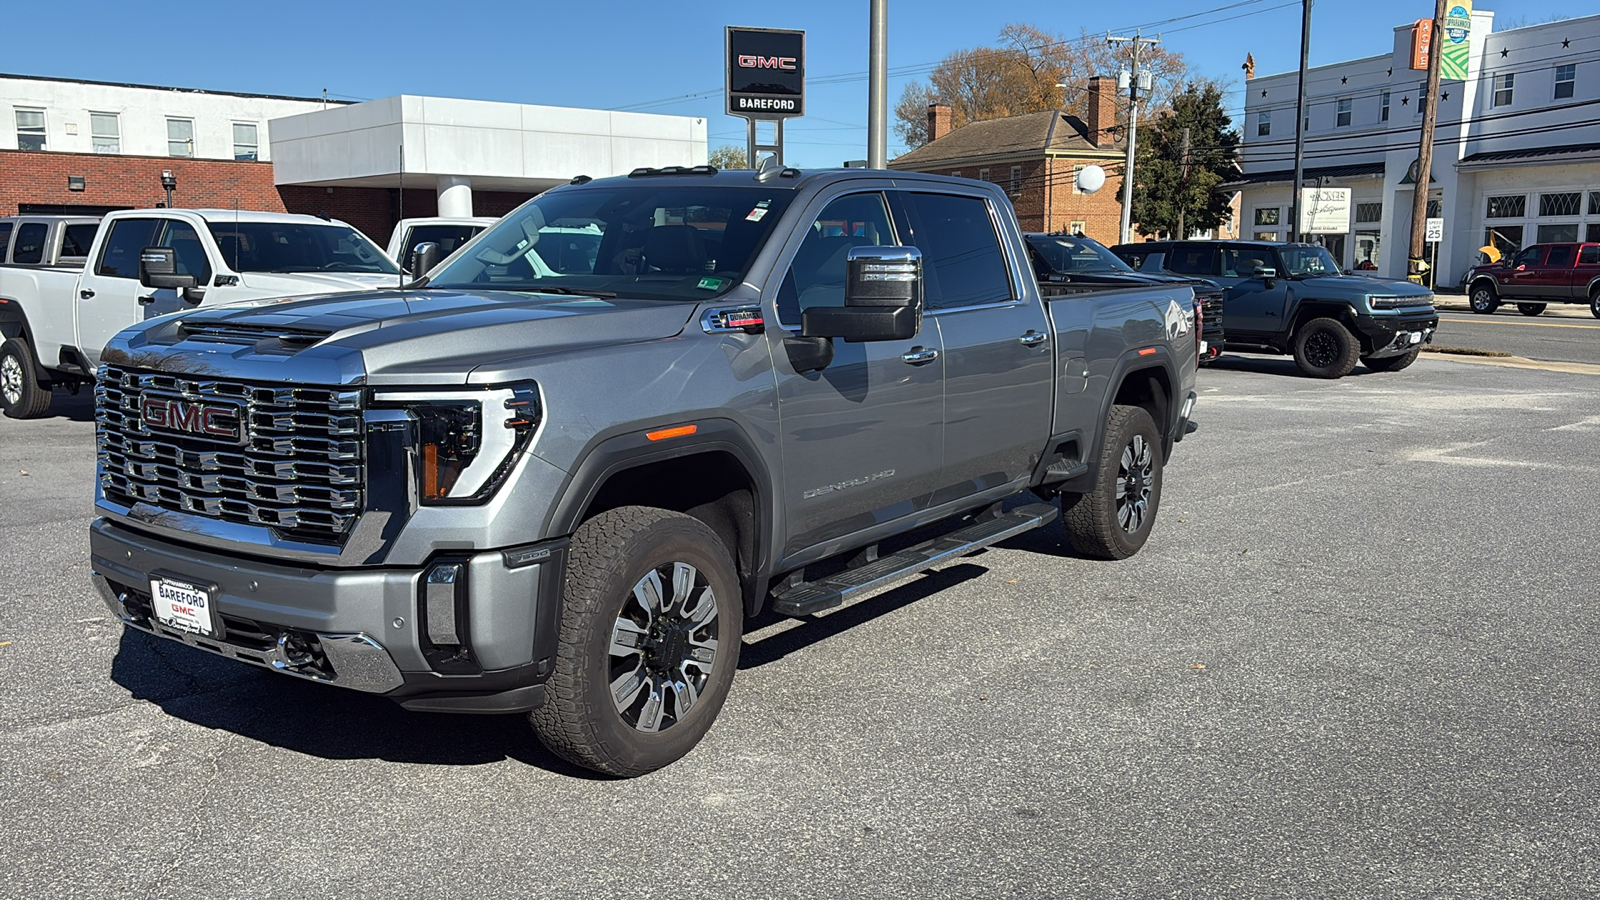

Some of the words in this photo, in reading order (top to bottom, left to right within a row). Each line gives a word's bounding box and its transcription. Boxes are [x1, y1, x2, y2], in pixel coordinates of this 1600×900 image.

[1420, 22, 1429, 66] ACME
[738, 54, 797, 70] GMC
[739, 98, 795, 110] BAREFORD
[1428, 230, 1441, 239] 25
[143, 400, 238, 437] GMC
[368, 423, 407, 432] HD
[803, 478, 869, 500] DENALI
[871, 468, 896, 482] HD
[510, 548, 551, 564] 2500
[159, 586, 205, 608] BAREFORD
[171, 603, 196, 617] GMC
